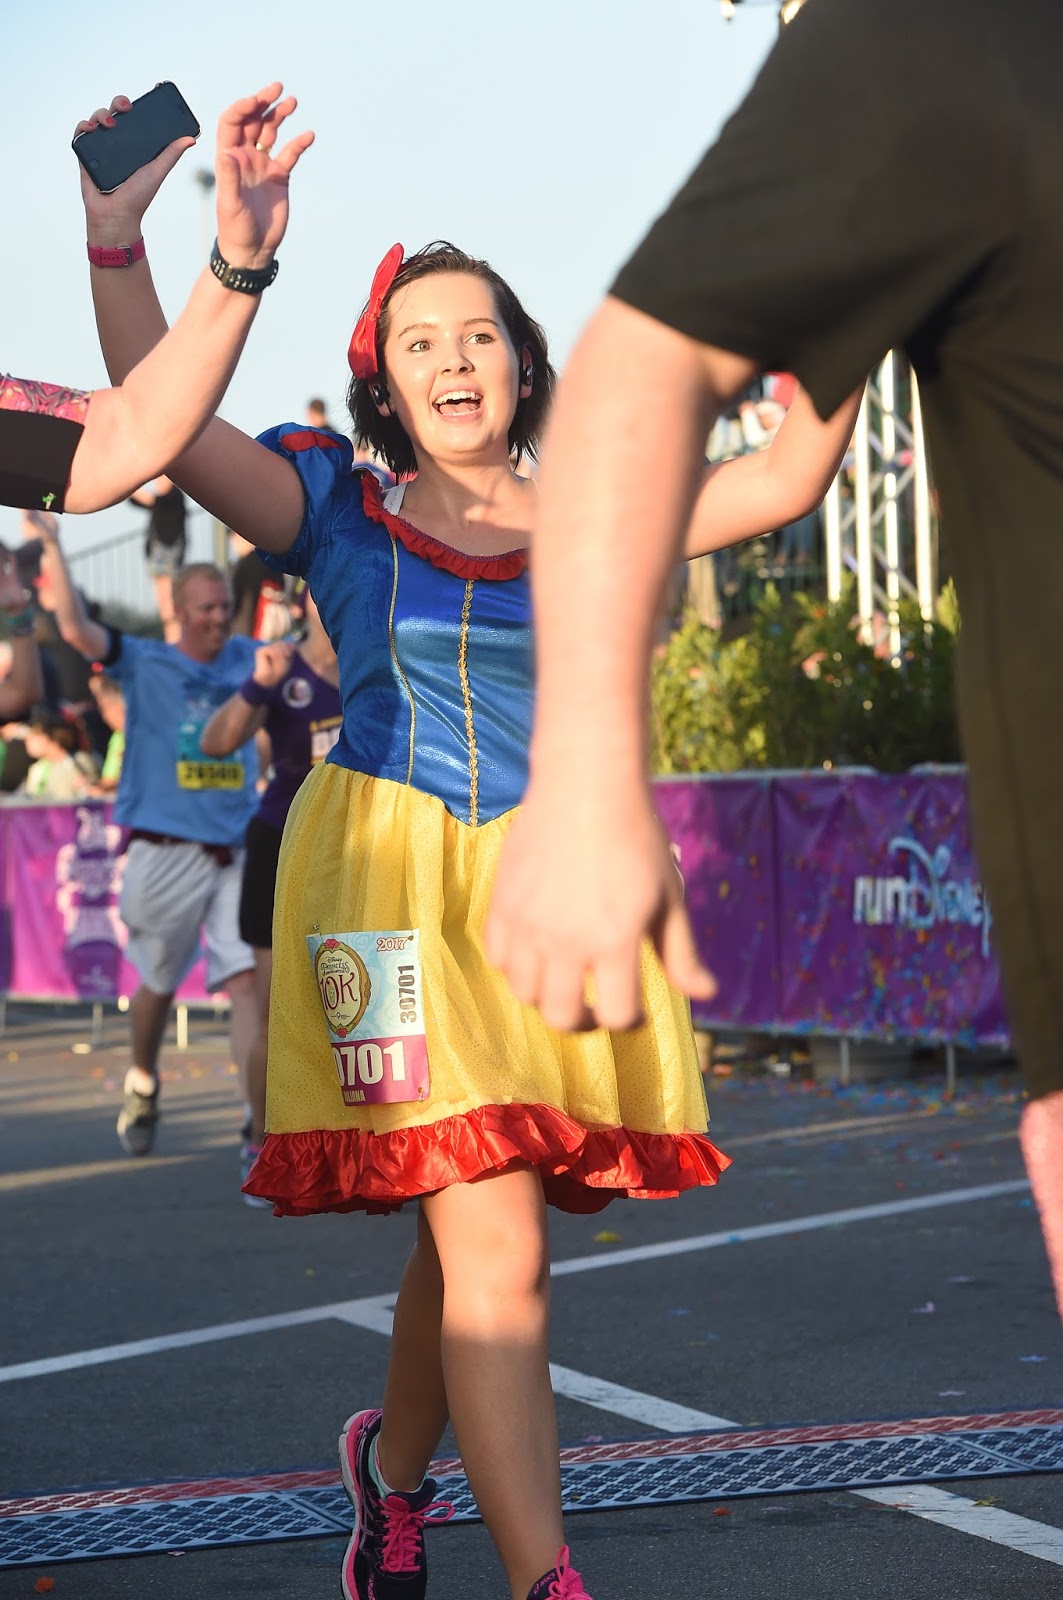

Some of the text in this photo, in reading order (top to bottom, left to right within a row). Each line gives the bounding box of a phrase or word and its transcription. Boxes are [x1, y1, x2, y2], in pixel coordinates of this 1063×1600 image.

[377, 936, 409, 952] 2017
[320, 972, 358, 1010] 10K
[398, 965, 416, 1024] 30701
